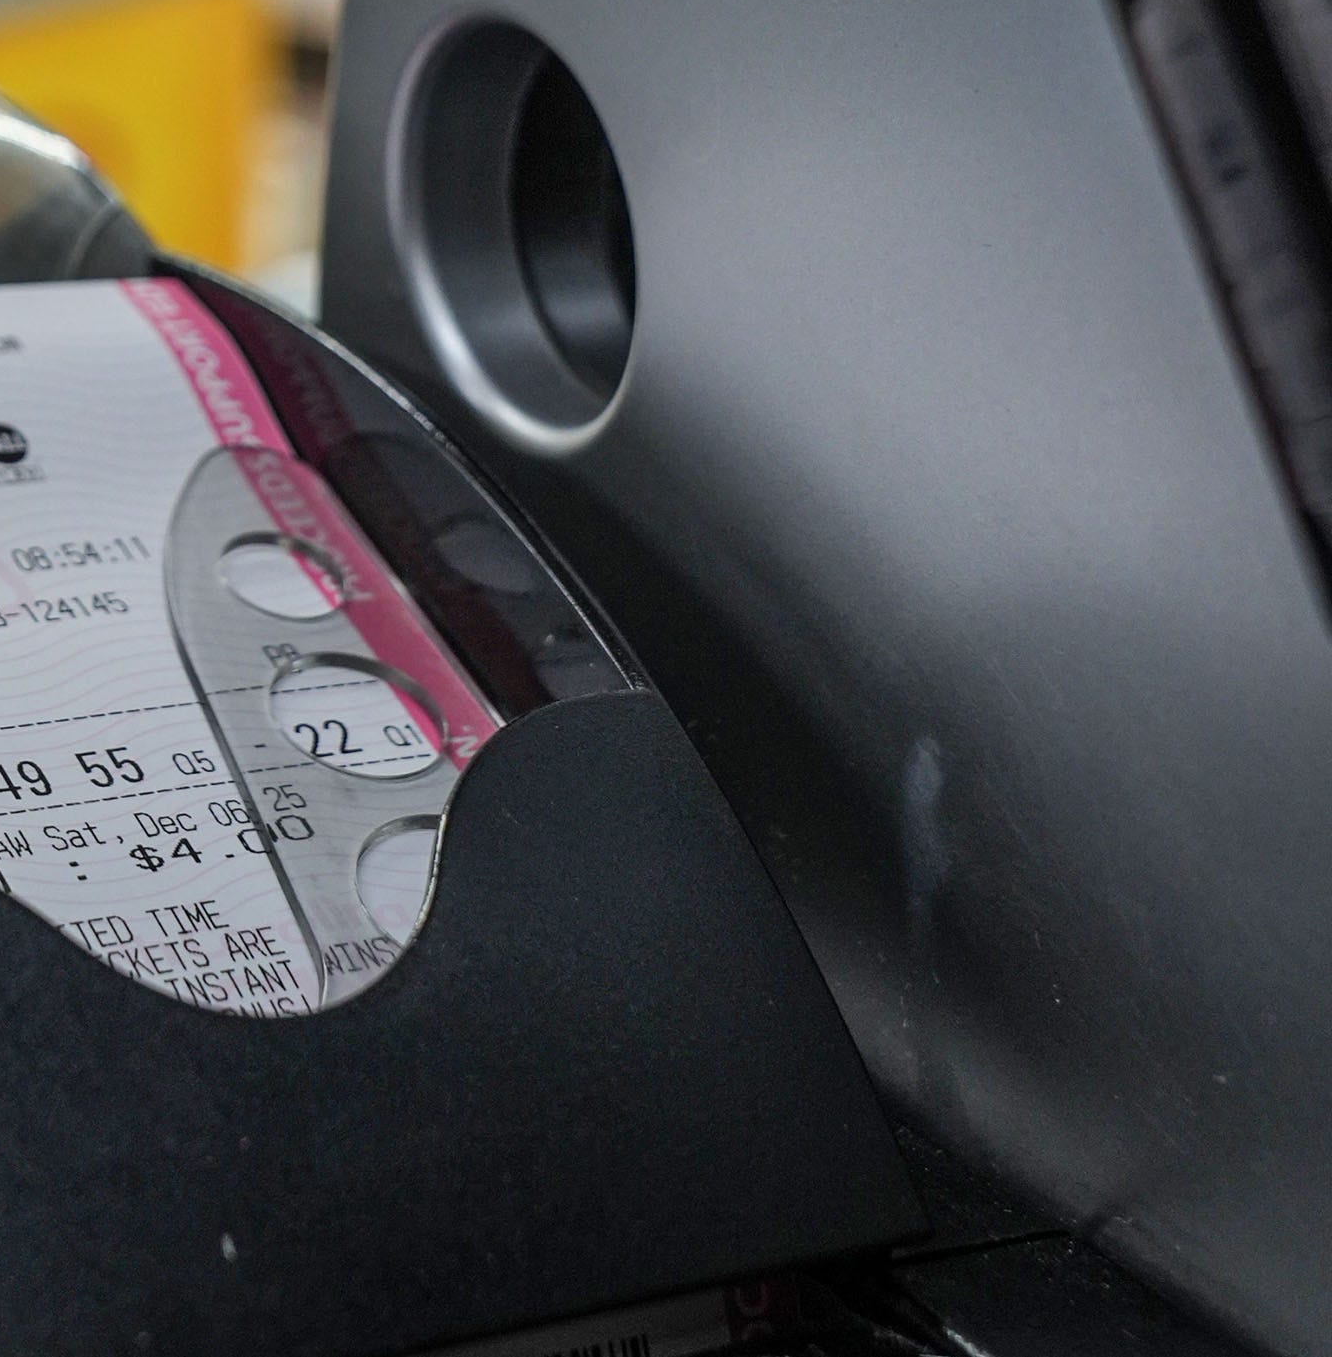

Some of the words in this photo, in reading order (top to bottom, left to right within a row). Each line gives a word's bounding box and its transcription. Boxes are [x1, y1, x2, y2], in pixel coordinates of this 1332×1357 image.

[11, 536, 151, 572] 08:54:11
[75, 747, 144, 787] 55
[294, 719, 363, 758] 22
[43, 821, 124, 851] Sat,
[133, 811, 198, 838] Dec
[59, 915, 135, 951] TED
[145, 900, 230, 937] TIME
[96, 938, 210, 979] CKETS
[224, 927, 286, 962] ARE
[164, 959, 299, 1009] INSTANT
